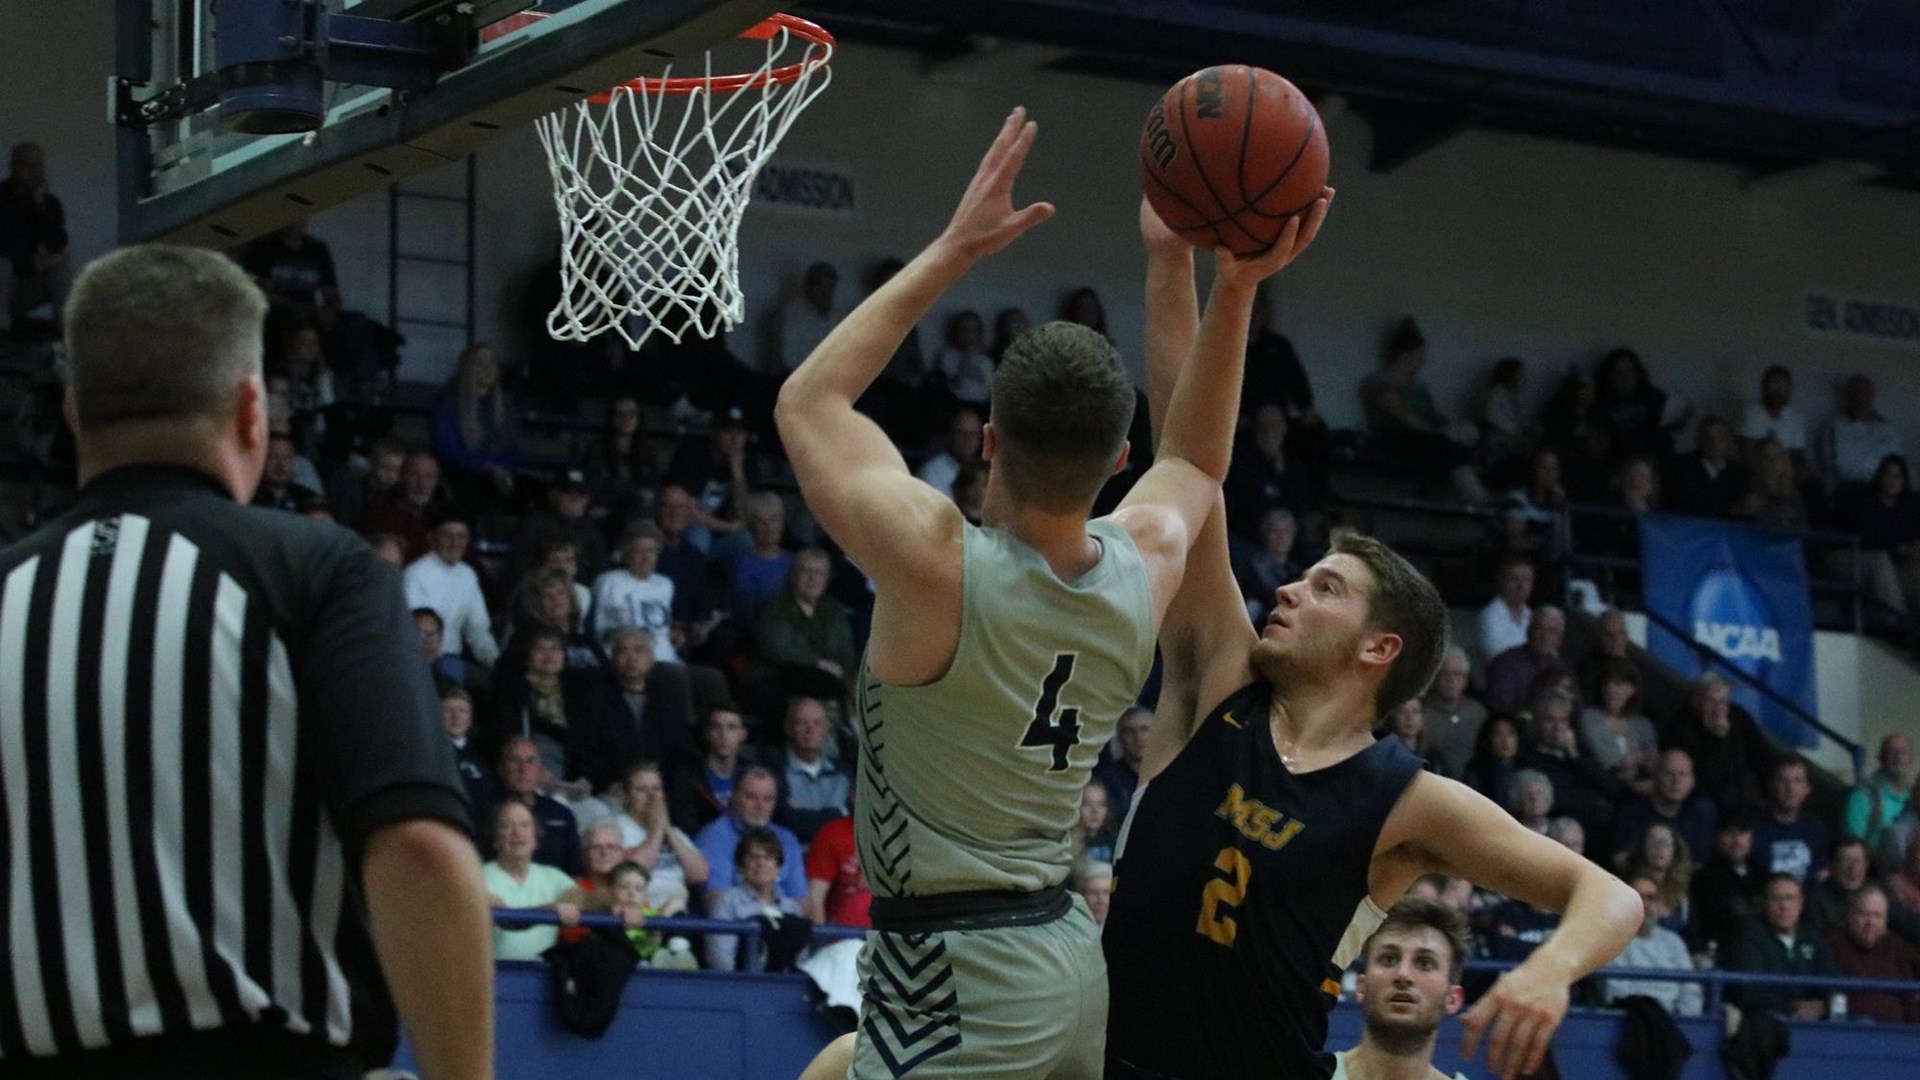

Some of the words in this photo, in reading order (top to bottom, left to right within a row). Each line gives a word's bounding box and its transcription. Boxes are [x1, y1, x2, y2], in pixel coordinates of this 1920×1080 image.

[1693, 619, 1783, 663] NCAA
[1018, 651, 1082, 772] 4
[1213, 781, 1306, 851] MSJ
[1195, 846, 1252, 948] 2
